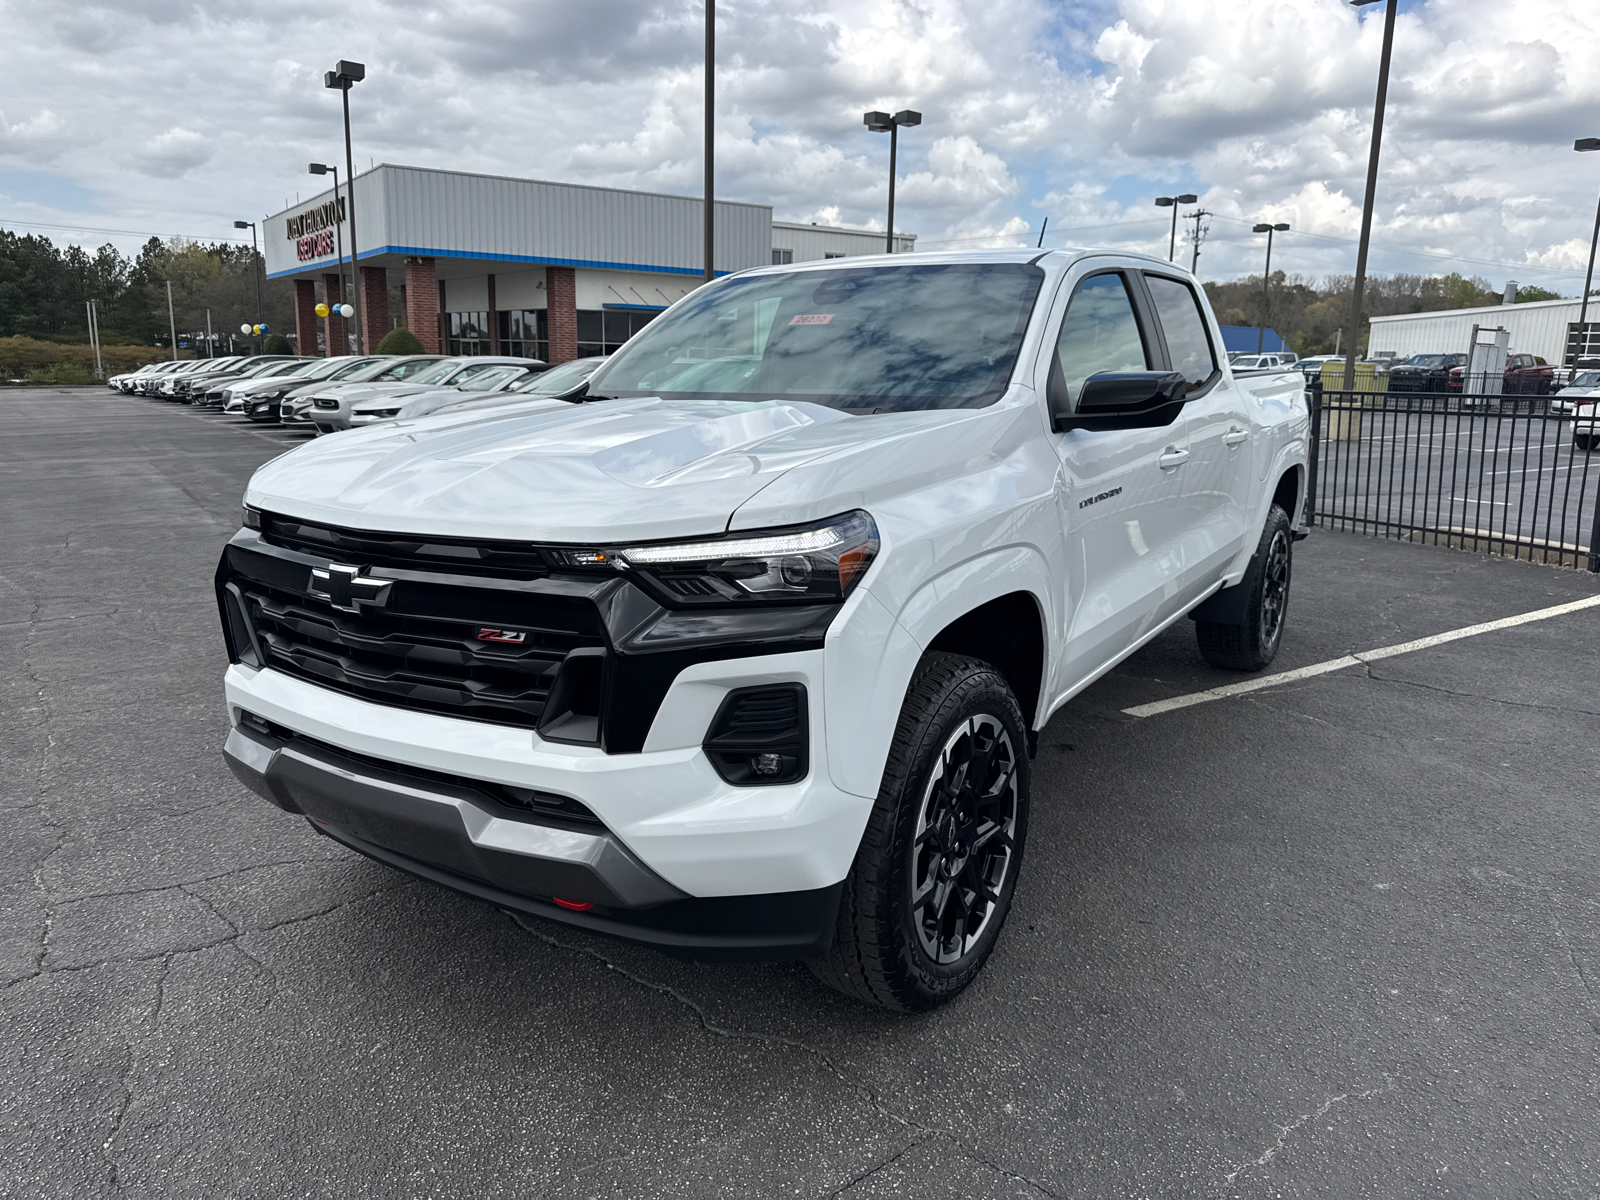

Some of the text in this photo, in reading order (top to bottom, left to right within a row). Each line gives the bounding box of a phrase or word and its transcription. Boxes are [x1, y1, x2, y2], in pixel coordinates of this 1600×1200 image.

[296, 230, 334, 261] USED CARS
[795, 315, 827, 324] 26230
[477, 628, 526, 644] Z71
